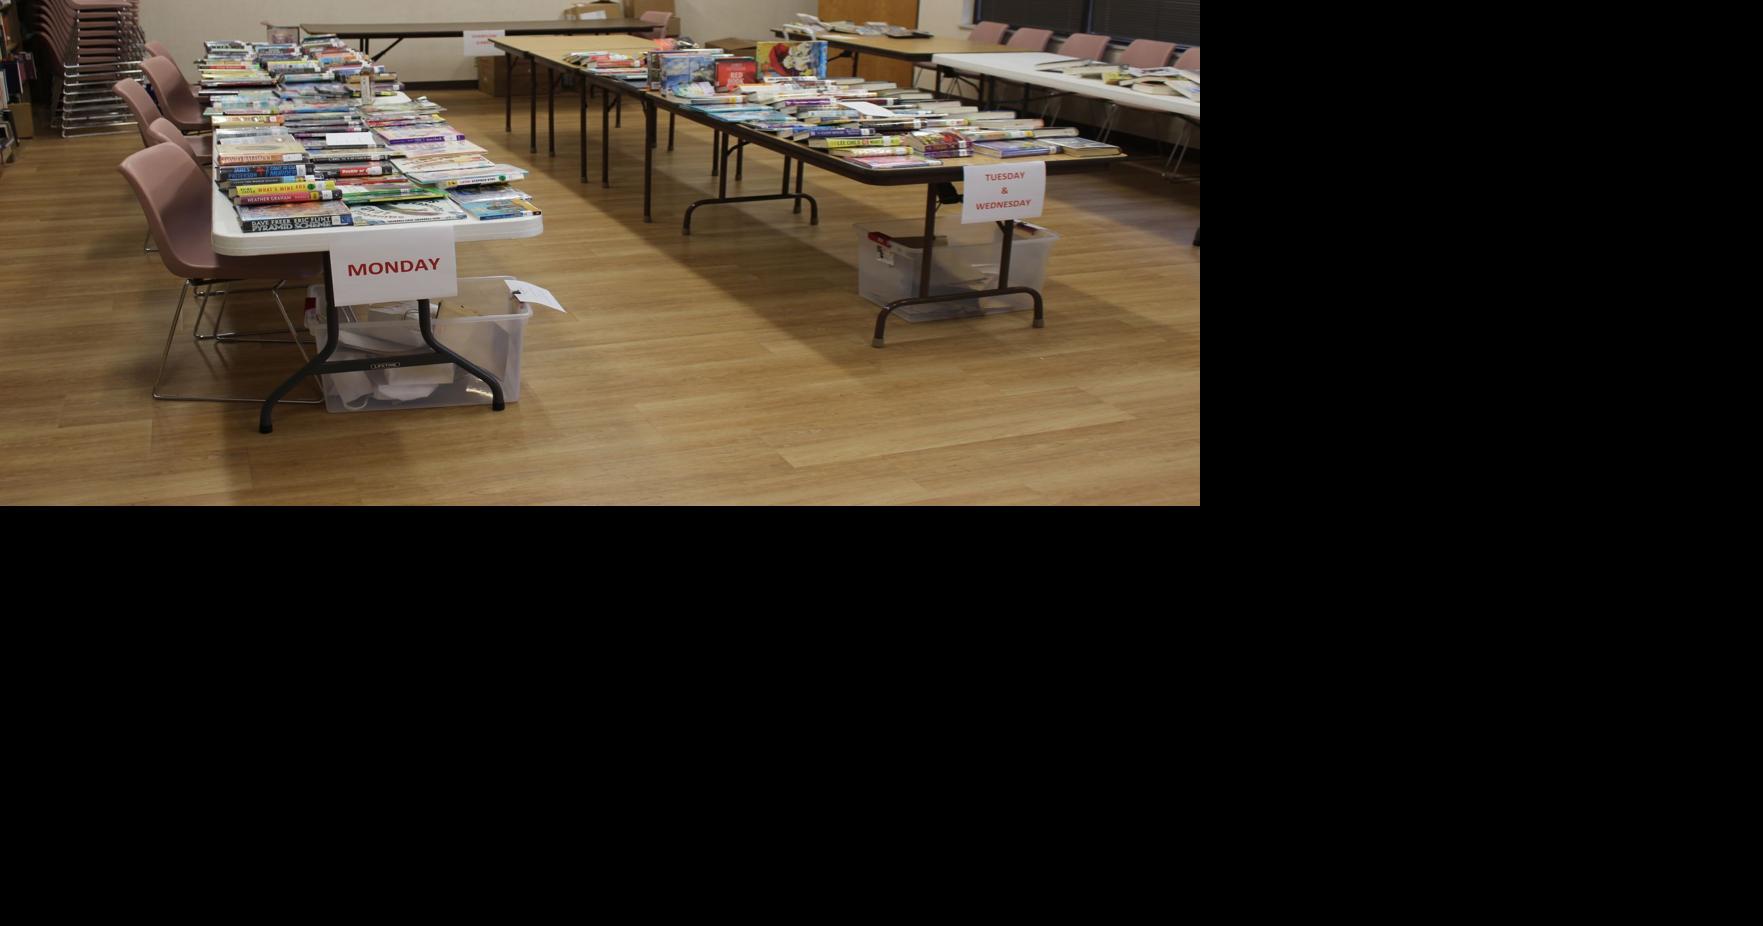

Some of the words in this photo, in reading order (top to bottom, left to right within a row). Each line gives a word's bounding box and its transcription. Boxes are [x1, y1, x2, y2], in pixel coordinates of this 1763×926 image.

[985, 172, 1025, 181] TUESDAY
[247, 195, 270, 203] HEATHER
[271, 194, 291, 202] GRAHAM
[976, 199, 1032, 210] WEDNESDAY
[252, 223, 293, 232] PYRAMID
[294, 221, 332, 229] SCHEME
[348, 257, 440, 276] MONDAY
